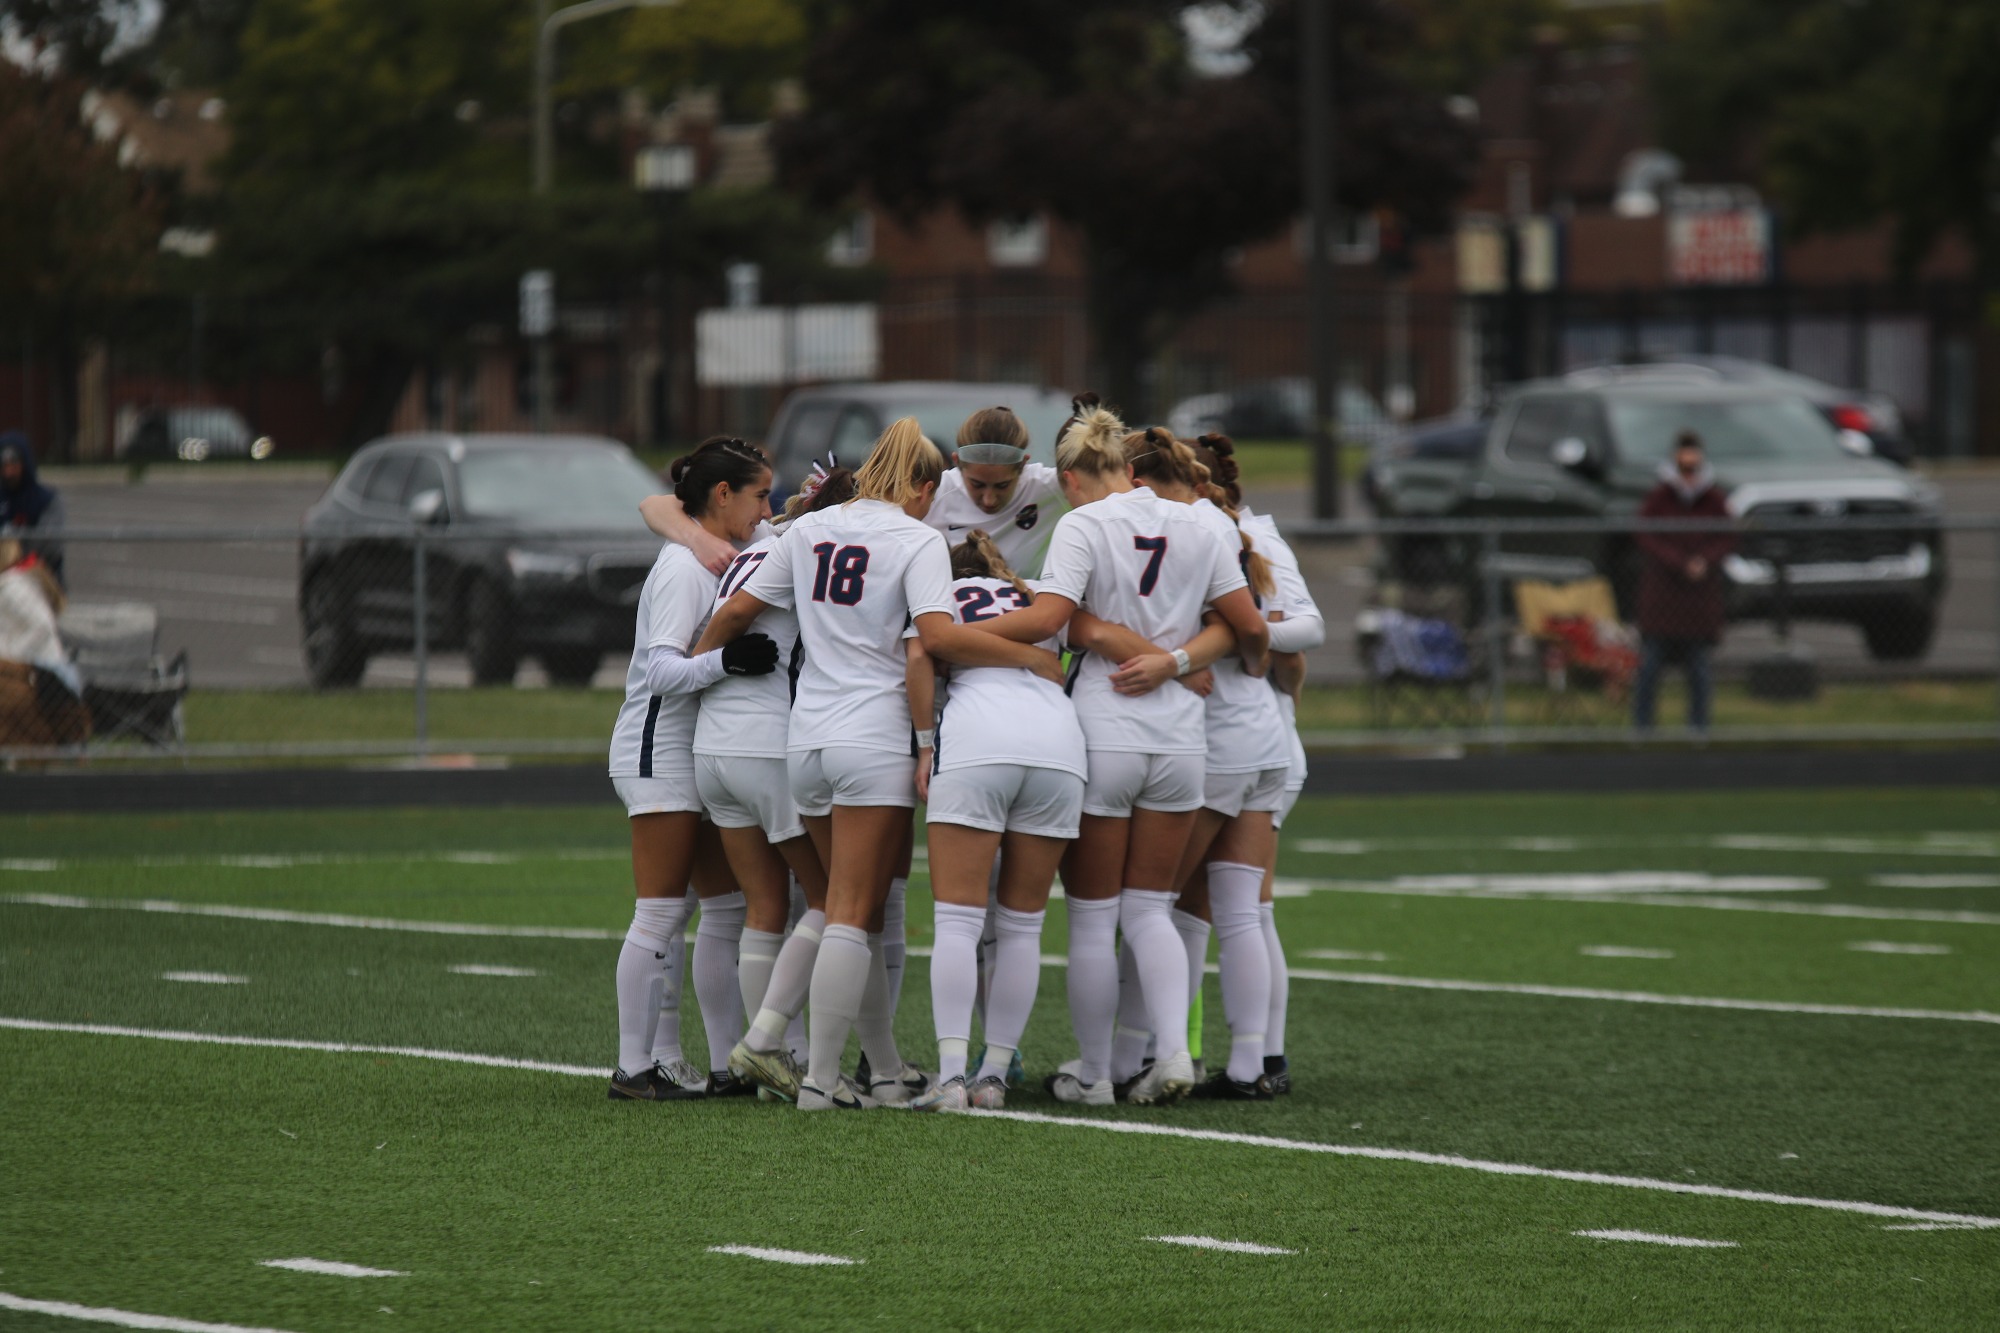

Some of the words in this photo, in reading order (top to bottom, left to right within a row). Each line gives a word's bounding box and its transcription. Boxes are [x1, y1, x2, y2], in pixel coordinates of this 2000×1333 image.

[718, 551, 769, 599] 17
[812, 541, 870, 606] 18
[1134, 536, 1168, 597] 7
[953, 586, 1034, 624] 23
